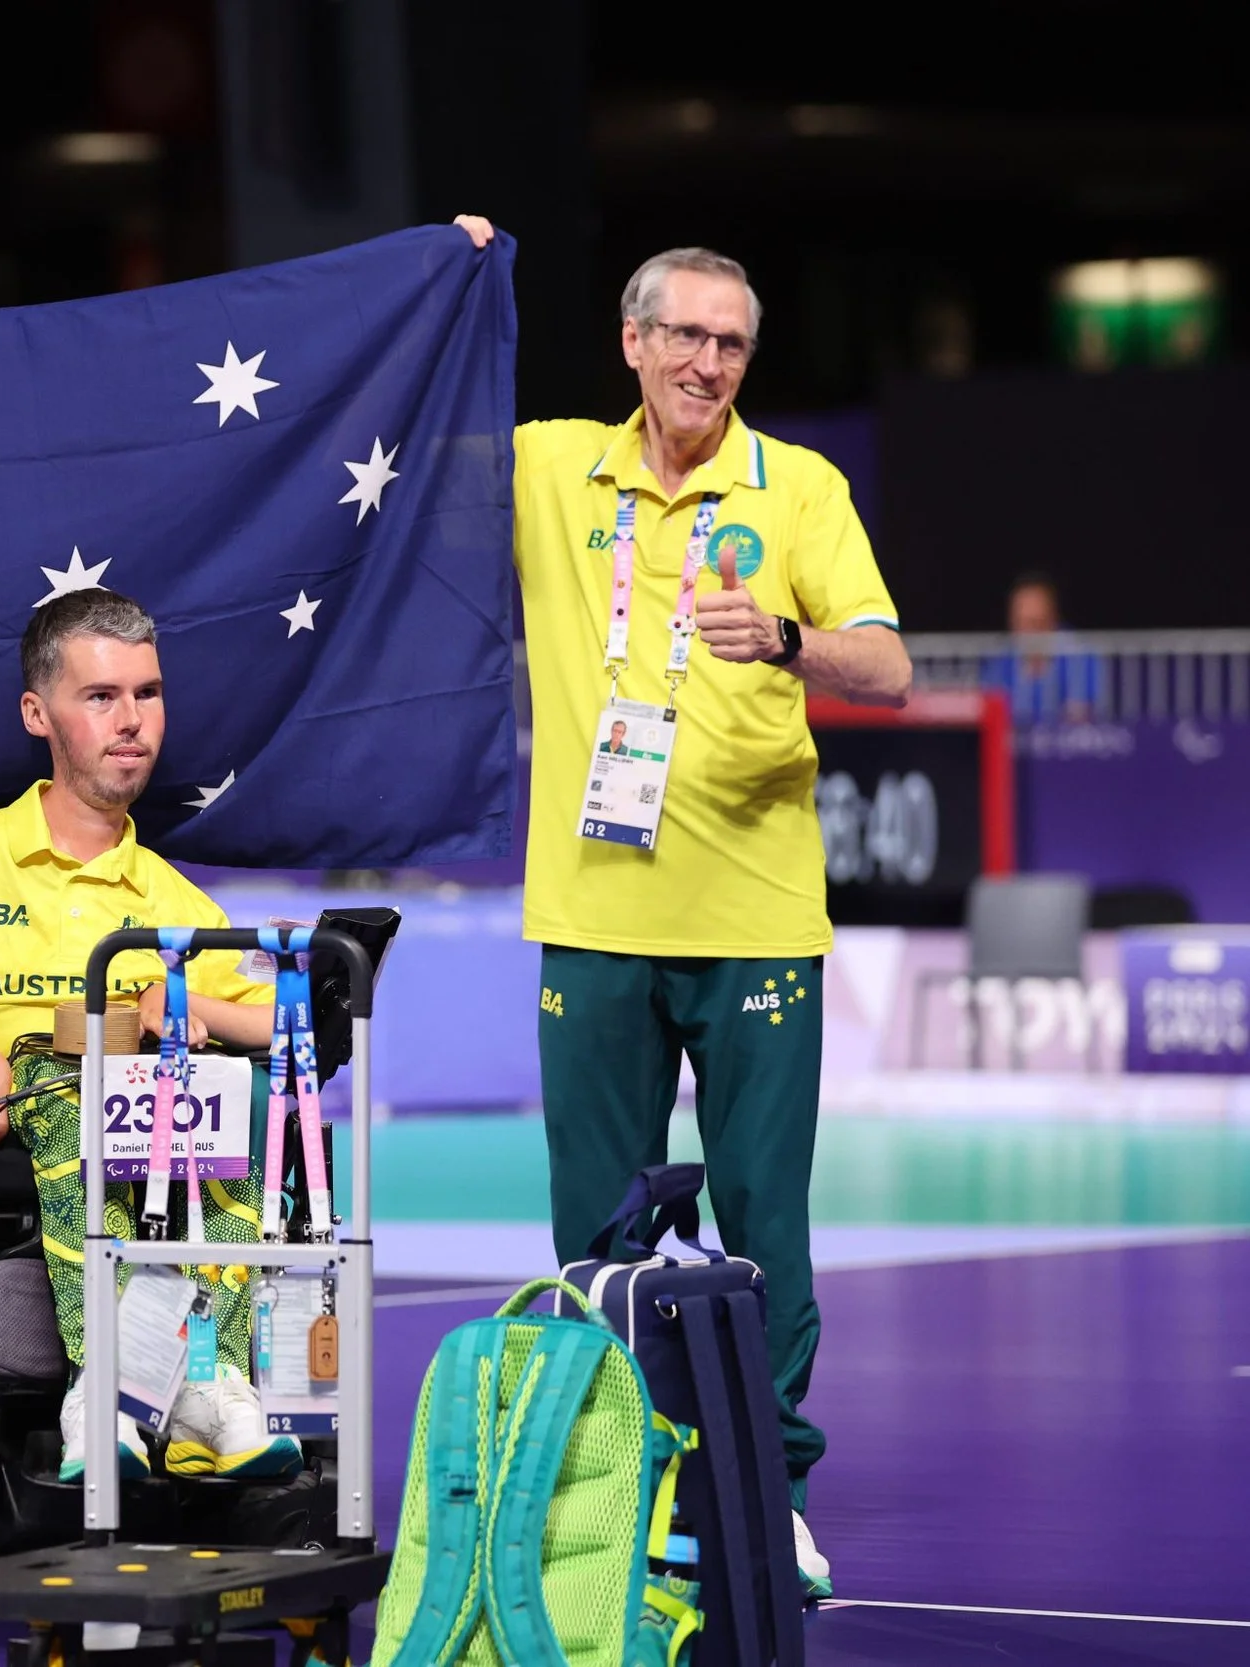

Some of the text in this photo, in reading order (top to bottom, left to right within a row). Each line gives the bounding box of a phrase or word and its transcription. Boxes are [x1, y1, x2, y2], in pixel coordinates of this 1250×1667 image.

[741, 992, 781, 1013] AUS
[104, 1093, 222, 1133] 2301
[112, 1143, 145, 1153] Daniel
[195, 1142, 215, 1152] AUS
[177, 1163, 214, 1174] 224
